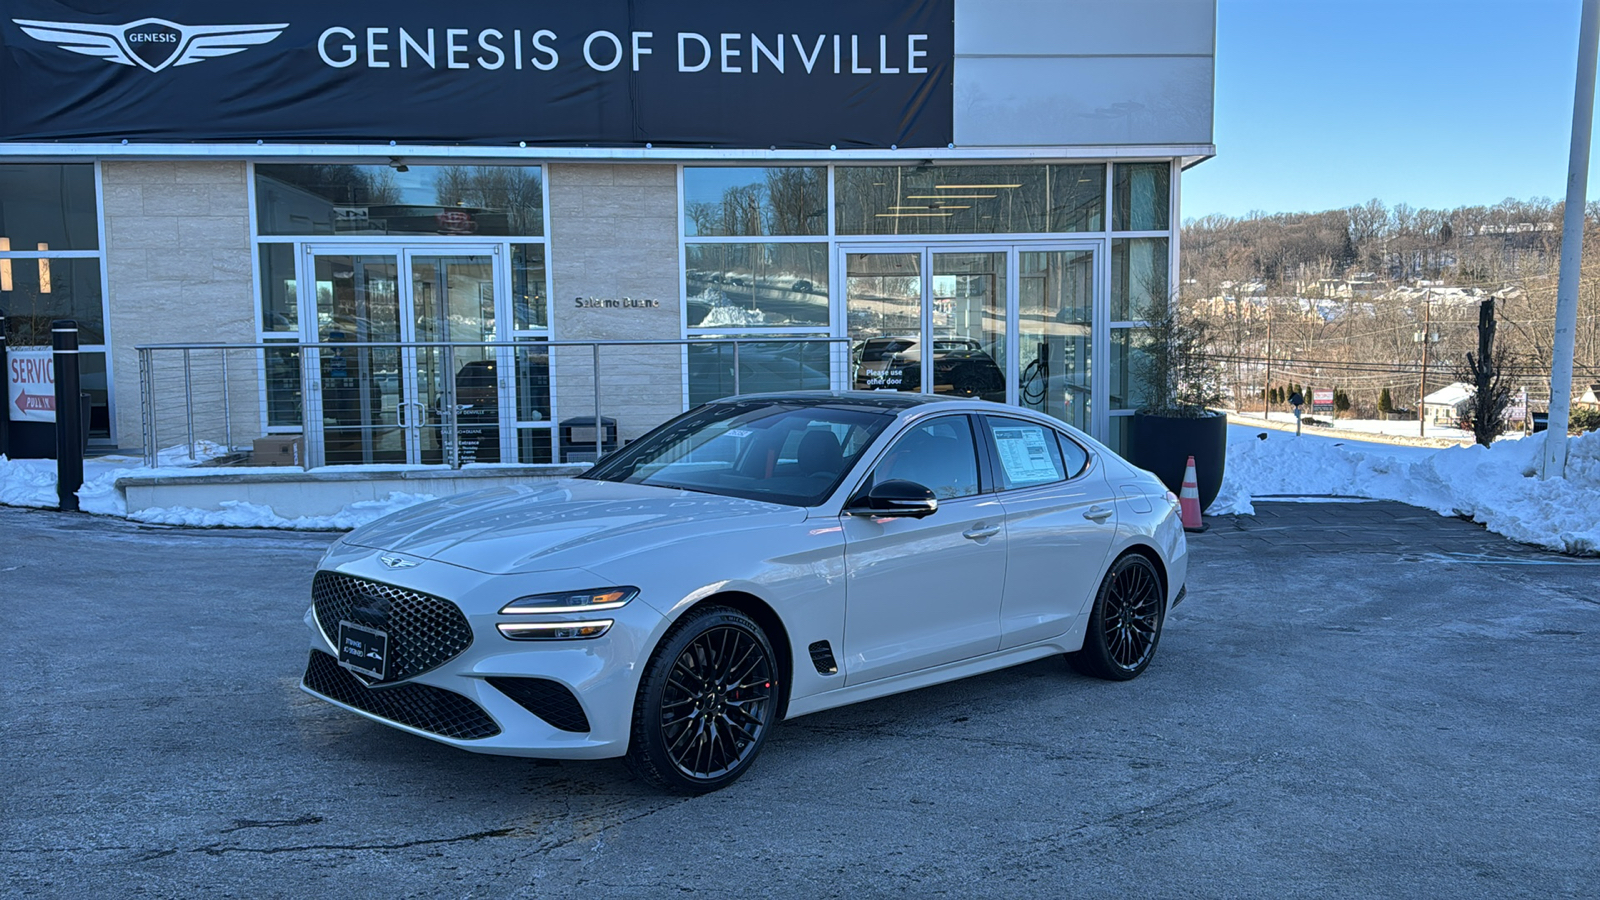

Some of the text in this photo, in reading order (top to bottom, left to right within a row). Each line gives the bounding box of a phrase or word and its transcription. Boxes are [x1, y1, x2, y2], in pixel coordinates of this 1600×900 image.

[129, 33, 177, 43] GENESIS
[317, 26, 928, 74] GENESIS OF DENVILLE
[575, 297, 660, 308] Salerno Duane
[11, 358, 54, 384] SERVIC
[27, 397, 42, 408] PULL
